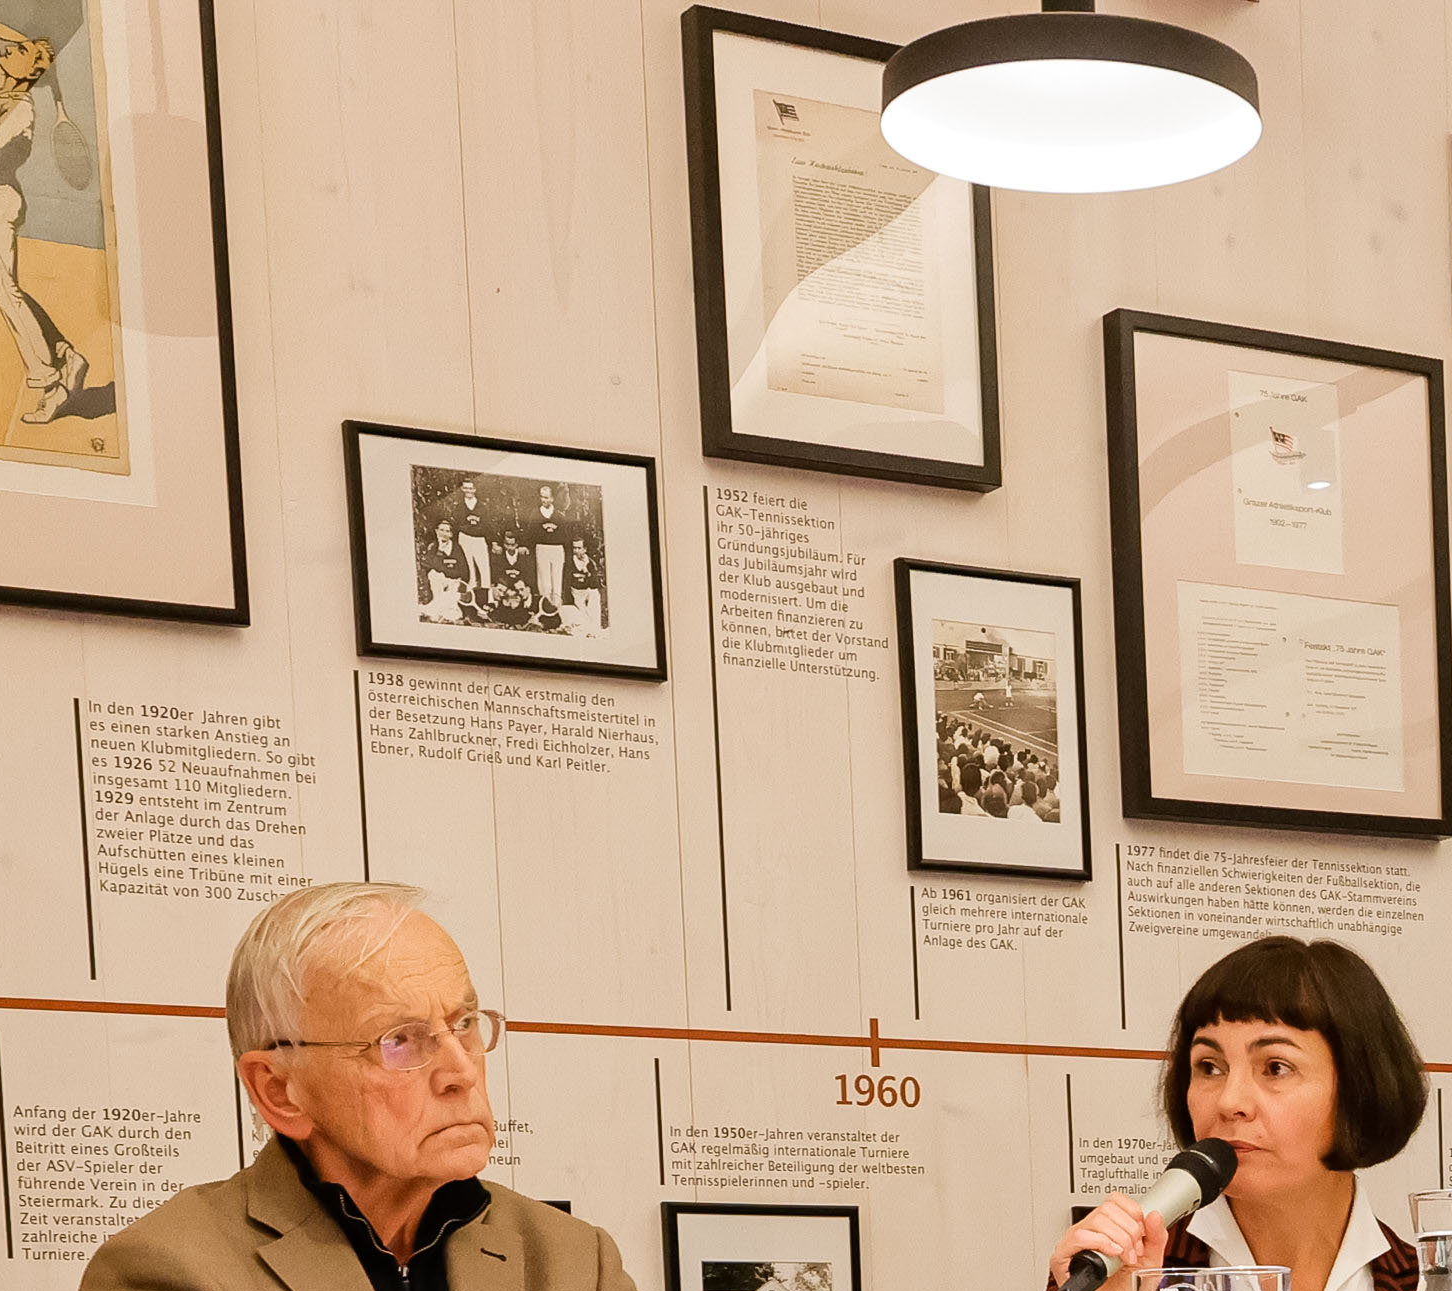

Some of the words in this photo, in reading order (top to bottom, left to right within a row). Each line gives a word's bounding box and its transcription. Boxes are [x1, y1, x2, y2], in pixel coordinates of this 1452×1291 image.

[717, 488, 748, 504] 1952
[753, 492, 784, 507] feiert
[789, 496, 807, 510] die
[716, 504, 834, 529] GAK-Tennissektion
[368, 672, 404, 688] 1938
[409, 678, 462, 693] gewinnt
[467, 681, 489, 695] der
[493, 683, 520, 698] GAK
[526, 689, 586, 708] erstmalig
[591, 692, 614, 707] den
[89, 699, 101, 713] In
[107, 701, 133, 716] den
[141, 704, 193, 721] 1920er
[203, 709, 247, 726] Jahren
[253, 714, 280, 730] gibt
[368, 705, 390, 720] der
[396, 708, 465, 730] Besetzung
[470, 715, 502, 730] Hans
[508, 718, 546, 736] Payer,
[552, 722, 593, 739] Harald
[598, 727, 658, 747] Nierhaus,
[90, 721, 105, 732] es
[110, 720, 150, 735] einen
[156, 725, 209, 740] starken
[214, 728, 268, 749] Anstieg
[273, 736, 289, 747] an
[91, 739, 135, 752] neuen
[141, 740, 260, 762] Klubmitgliedern.
[266, 750, 282, 764] So
[288, 752, 314, 768] gibt
[92, 757, 107, 767] es
[114, 755, 152, 771] 1926
[158, 759, 175, 773] 52
[182, 761, 289, 782] Neuaufnahmen
[295, 770, 315, 784] bei
[96, 790, 133, 805] 1929
[139, 795, 198, 810] entsteht
[204, 798, 220, 811] im
[227, 799, 286, 816] Zentrum
[1127, 845, 1155, 859] 1977
[1159, 847, 1190, 861] findet
[1193, 850, 1209, 862] die
[1291, 857, 1307, 869] der
[1386, 865, 1409, 877] statt.
[921, 887, 936, 900] Ab
[942, 888, 970, 902] 1961
[976, 892, 1036, 906] organisiert
[1040, 894, 1058, 907] der
[1062, 895, 1085, 908] GAK
[834, 1074, 922, 1108] 1960
[13, 1105, 66, 1124] Anfang
[72, 1106, 95, 1121] der
[103, 1107, 200, 1125] 1920er-Jahre
[14, 1123, 45, 1137] wird
[52, 1124, 75, 1138] der
[81, 1124, 112, 1139] GAK
[118, 1125, 159, 1140] durch
[164, 1126, 190, 1140] den
[670, 1125, 681, 1137] In
[686, 1125, 708, 1138] den
[714, 1126, 803, 1142] 1950er-Jahren
[807, 1129, 876, 1142] veranstaltet
[881, 1129, 899, 1142] der
[16, 1141, 65, 1155] Beitritt
[71, 1142, 108, 1156] eines
[114, 1143, 179, 1157] Großteils
[670, 1141, 696, 1154] GAK
[701, 1142, 768, 1159] regelmäßig
[774, 1143, 855, 1157] internationale
[859, 1145, 909, 1158] Turniere
[17, 1158, 40, 1172] der
[46, 1158, 133, 1177] ASV-Spieler
[139, 1160, 162, 1174] der
[672, 1158, 691, 1171] mit
[696, 1158, 763, 1172] zahlreicher
[768, 1159, 834, 1176] Beteiligung
[839, 1160, 857, 1173] der
[861, 1161, 924, 1174] weltbesten
